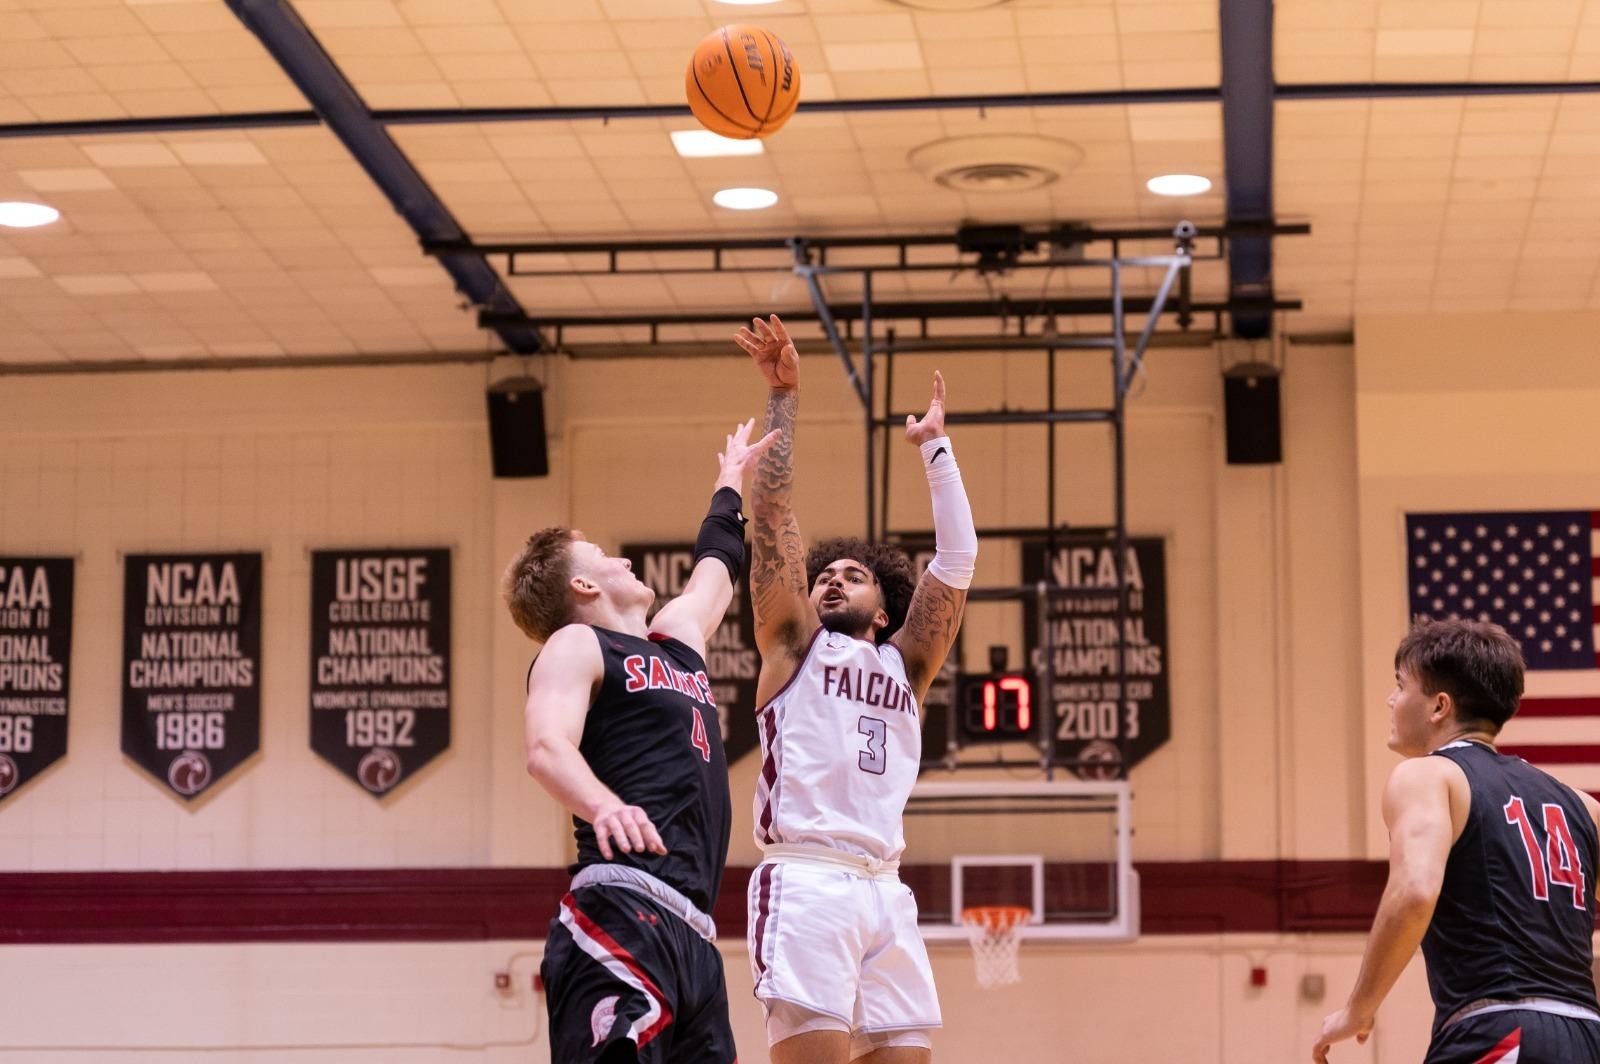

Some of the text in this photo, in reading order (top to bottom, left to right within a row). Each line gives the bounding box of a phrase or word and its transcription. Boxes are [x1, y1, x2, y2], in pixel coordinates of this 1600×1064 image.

[0, 566, 51, 609] AA
[147, 563, 240, 606] NCAA
[336, 558, 427, 601] USGF
[145, 607, 239, 626] DIVISION II
[328, 601, 431, 622] COLLEGIATE
[0, 635, 52, 662] ONAL
[142, 631, 242, 659] NATIONAL
[328, 627, 433, 656] NATIONAL
[0, 663, 63, 691] PIONS
[130, 658, 254, 688] CHAMPIONS
[317, 656, 444, 685] CHAMPIONS
[1031, 646, 1161, 676] CAMPINS
[823, 665, 917, 718] FALCON
[983, 676, 1031, 732] 17
[0, 715, 34, 752] 86
[156, 712, 225, 750] 1986
[346, 710, 416, 747] 1992
[691, 706, 710, 763] 4
[858, 715, 886, 775] 3
[1503, 794, 1586, 911] 14
